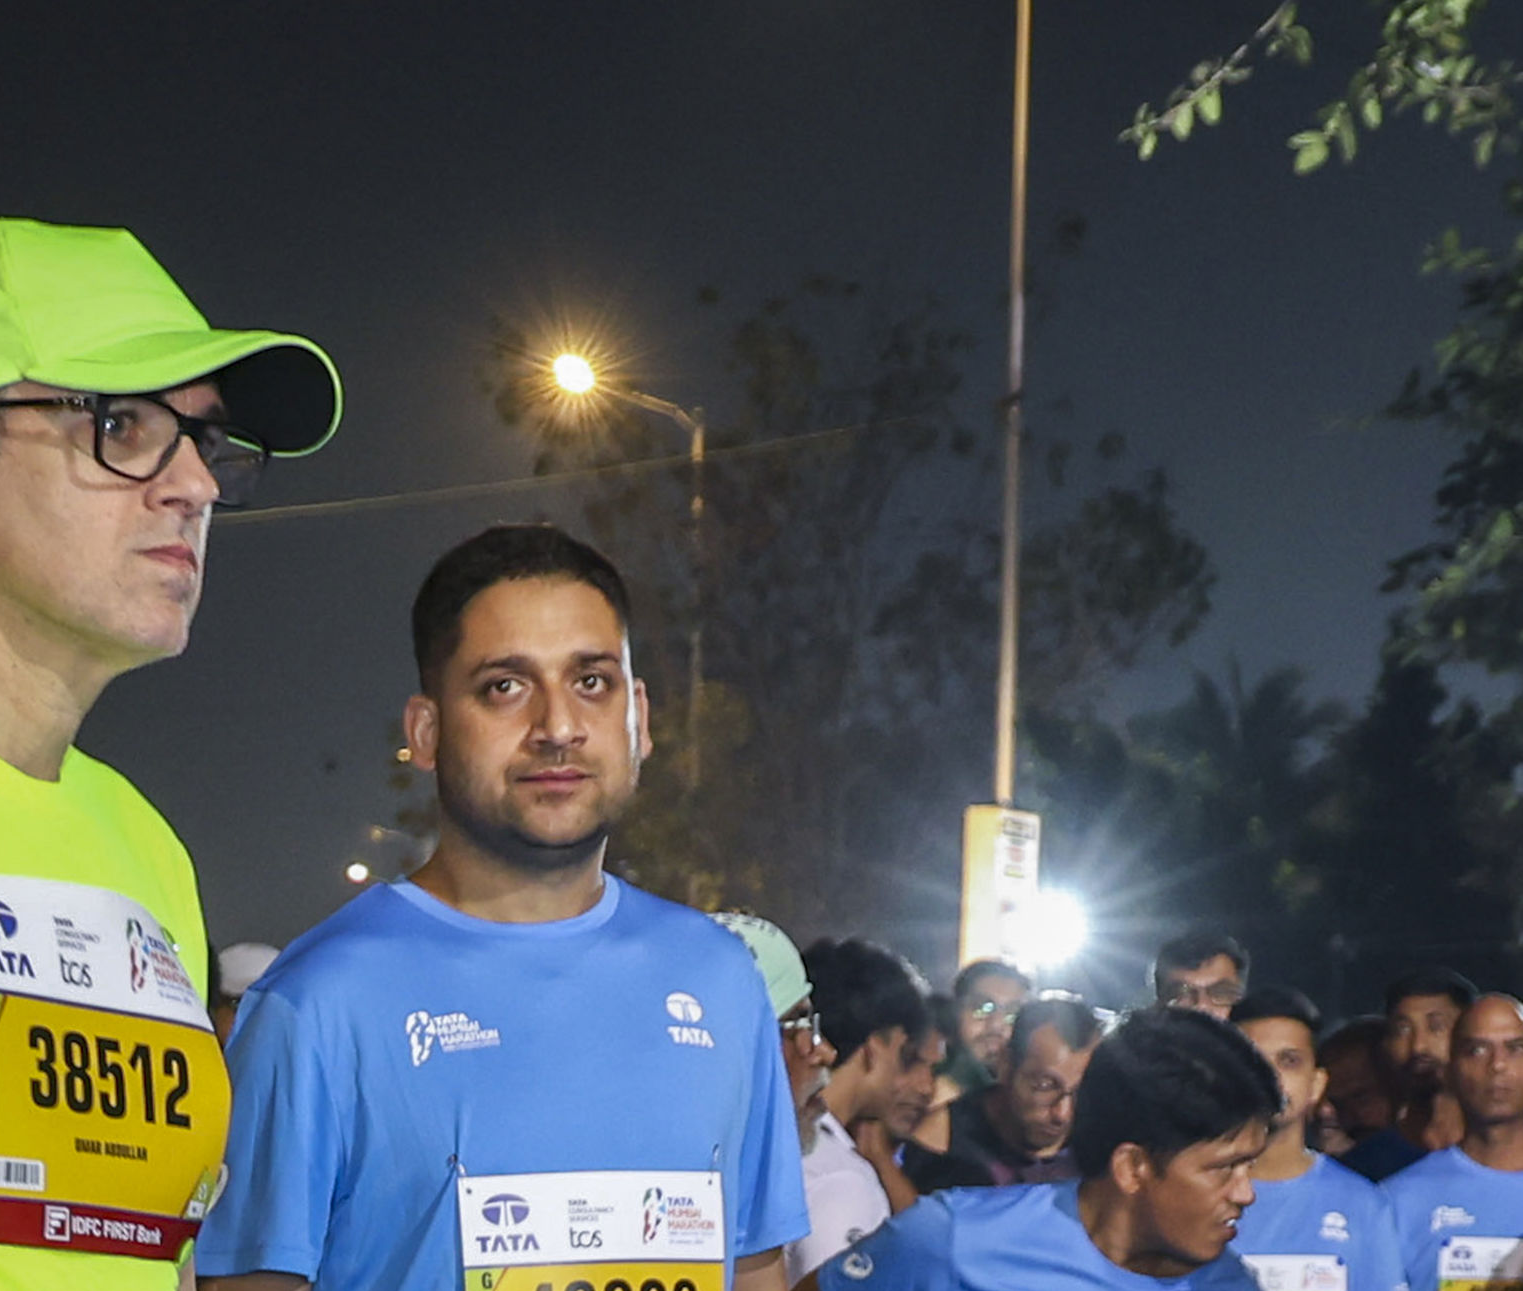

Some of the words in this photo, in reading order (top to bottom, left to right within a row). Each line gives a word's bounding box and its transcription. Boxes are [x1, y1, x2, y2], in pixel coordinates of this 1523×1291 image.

[59, 953, 93, 988] tcs
[667, 1026, 714, 1048] TATA
[29, 1025, 192, 1130] 38512
[103, 1219, 136, 1242] FIRST
[136, 1224, 162, 1246] Bank
[476, 1233, 541, 1254] TATA
[569, 1226, 603, 1248] tcs
[481, 1272, 493, 1290] G
